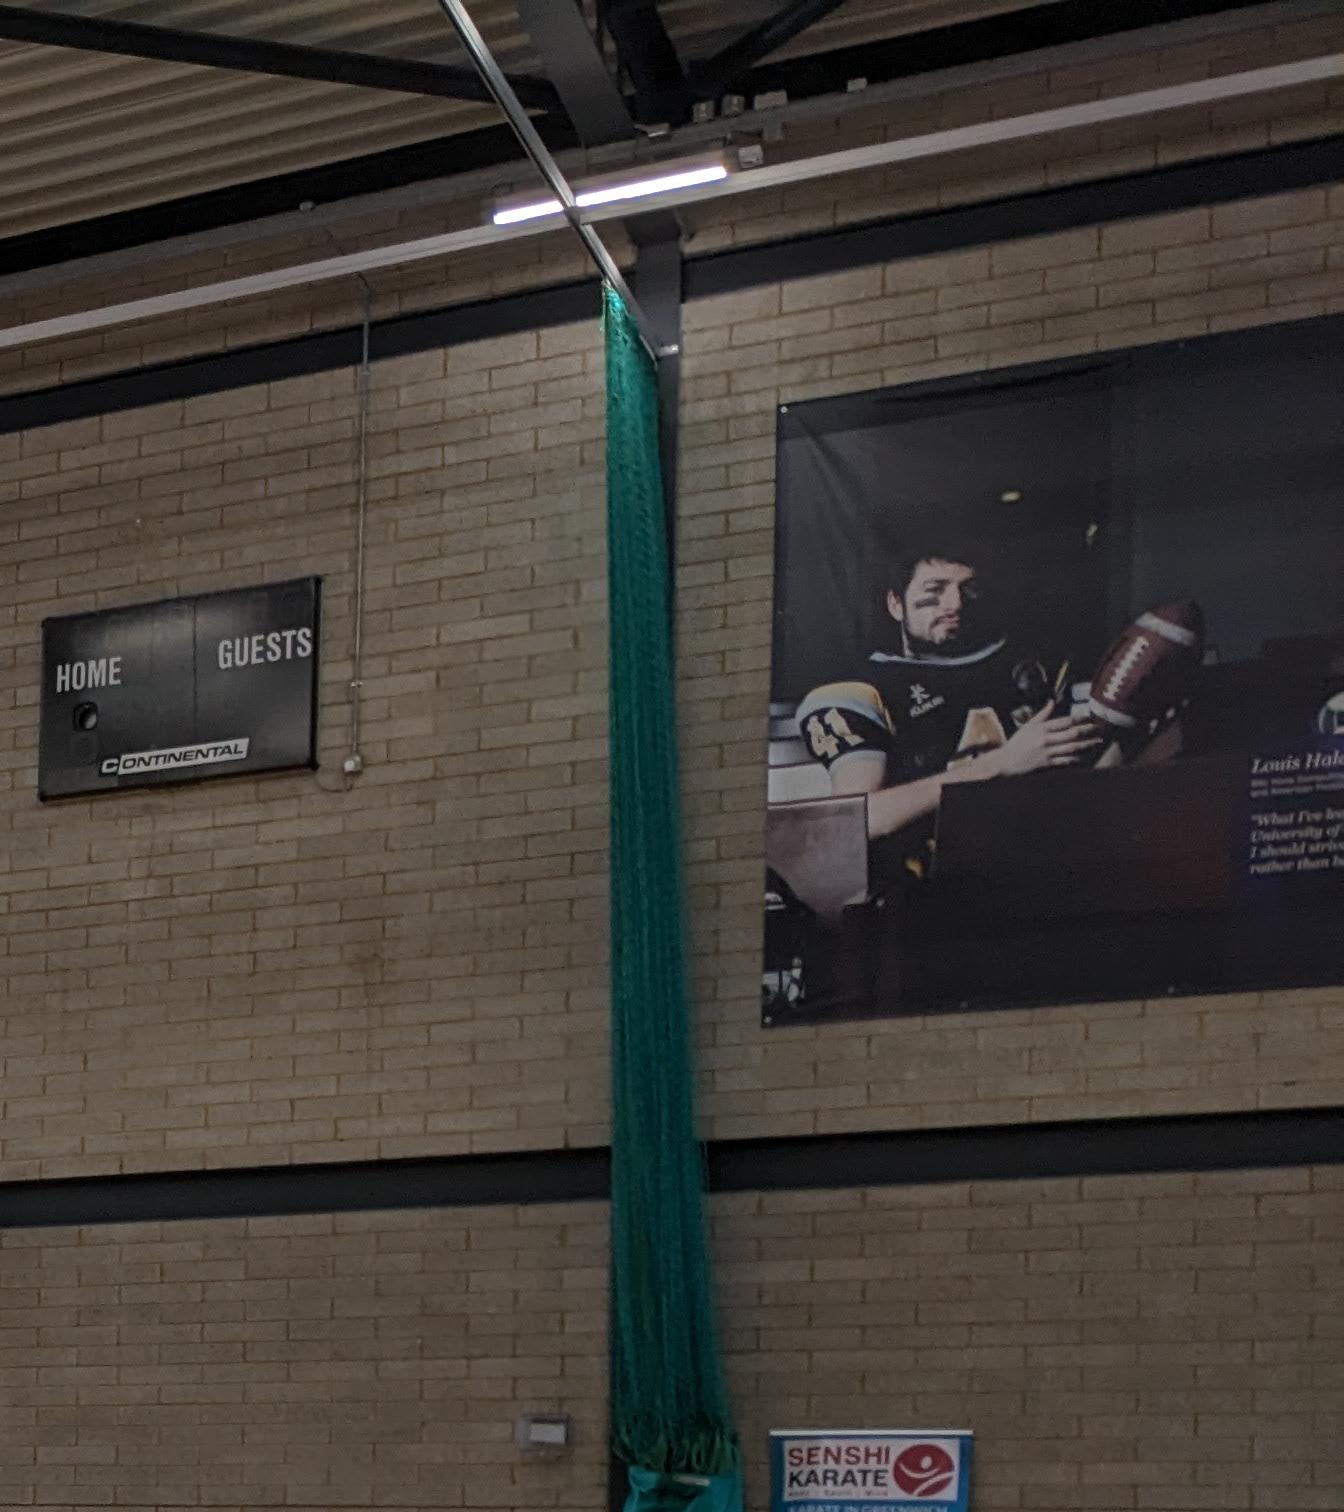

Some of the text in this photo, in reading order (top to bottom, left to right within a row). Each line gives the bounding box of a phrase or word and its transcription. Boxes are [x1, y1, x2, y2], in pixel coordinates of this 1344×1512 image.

[218, 627, 312, 670] GUESTS
[56, 656, 122, 693] HOME
[101, 742, 245, 774] CONTINENTAL
[1251, 755, 1300, 774] Louis
[788, 1445, 890, 1467] SENSHI
[788, 1469, 889, 1488] KARATE
